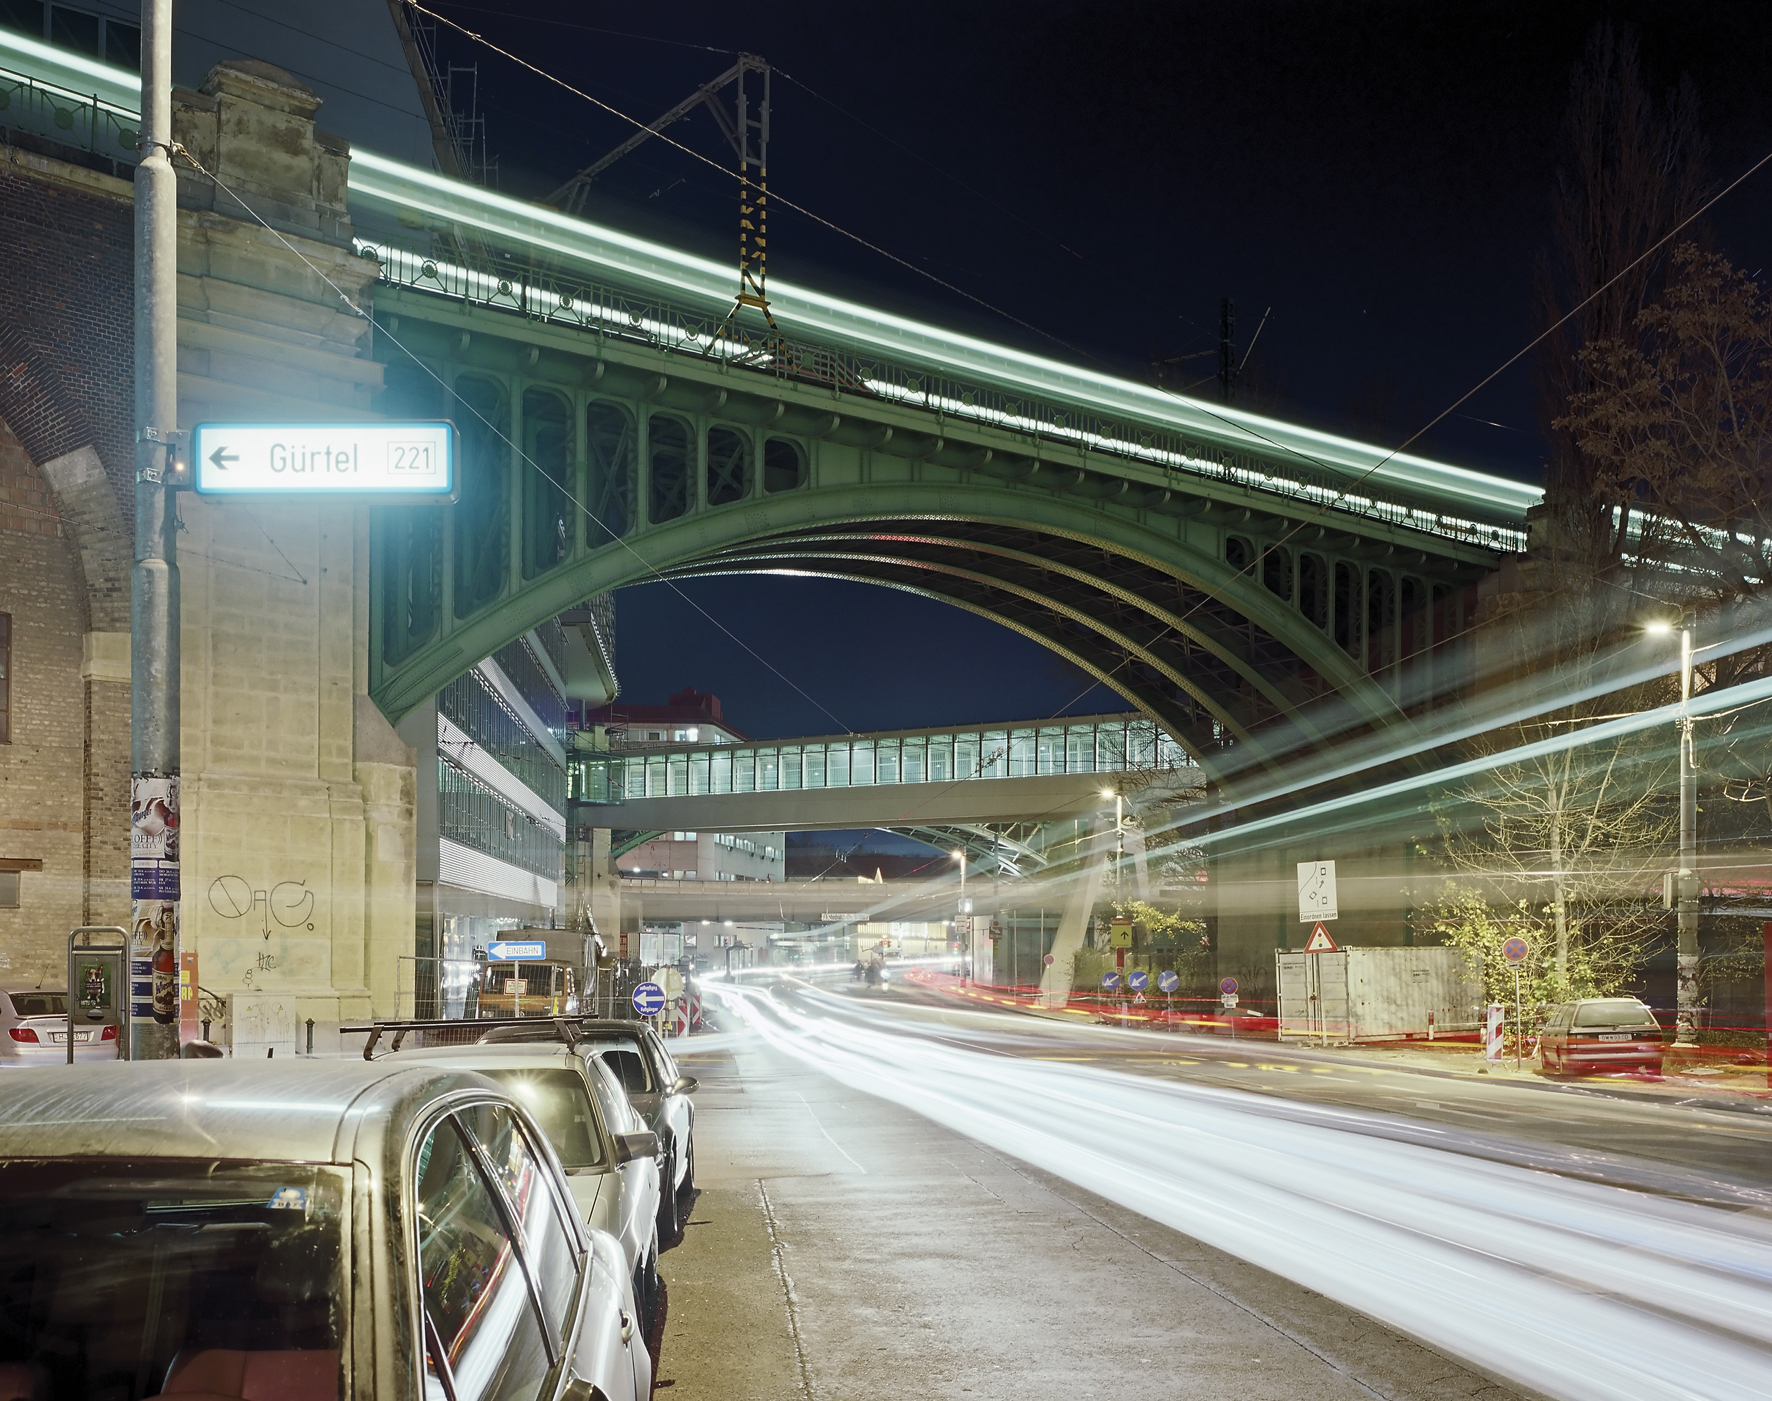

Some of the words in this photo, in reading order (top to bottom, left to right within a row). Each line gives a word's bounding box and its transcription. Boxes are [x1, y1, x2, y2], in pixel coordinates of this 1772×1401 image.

[269, 443, 358, 473] Gürtel
[394, 446, 430, 470] 221
[1300, 913, 1322, 921] Einordnen
[506, 947, 539, 955] EINBAHN
